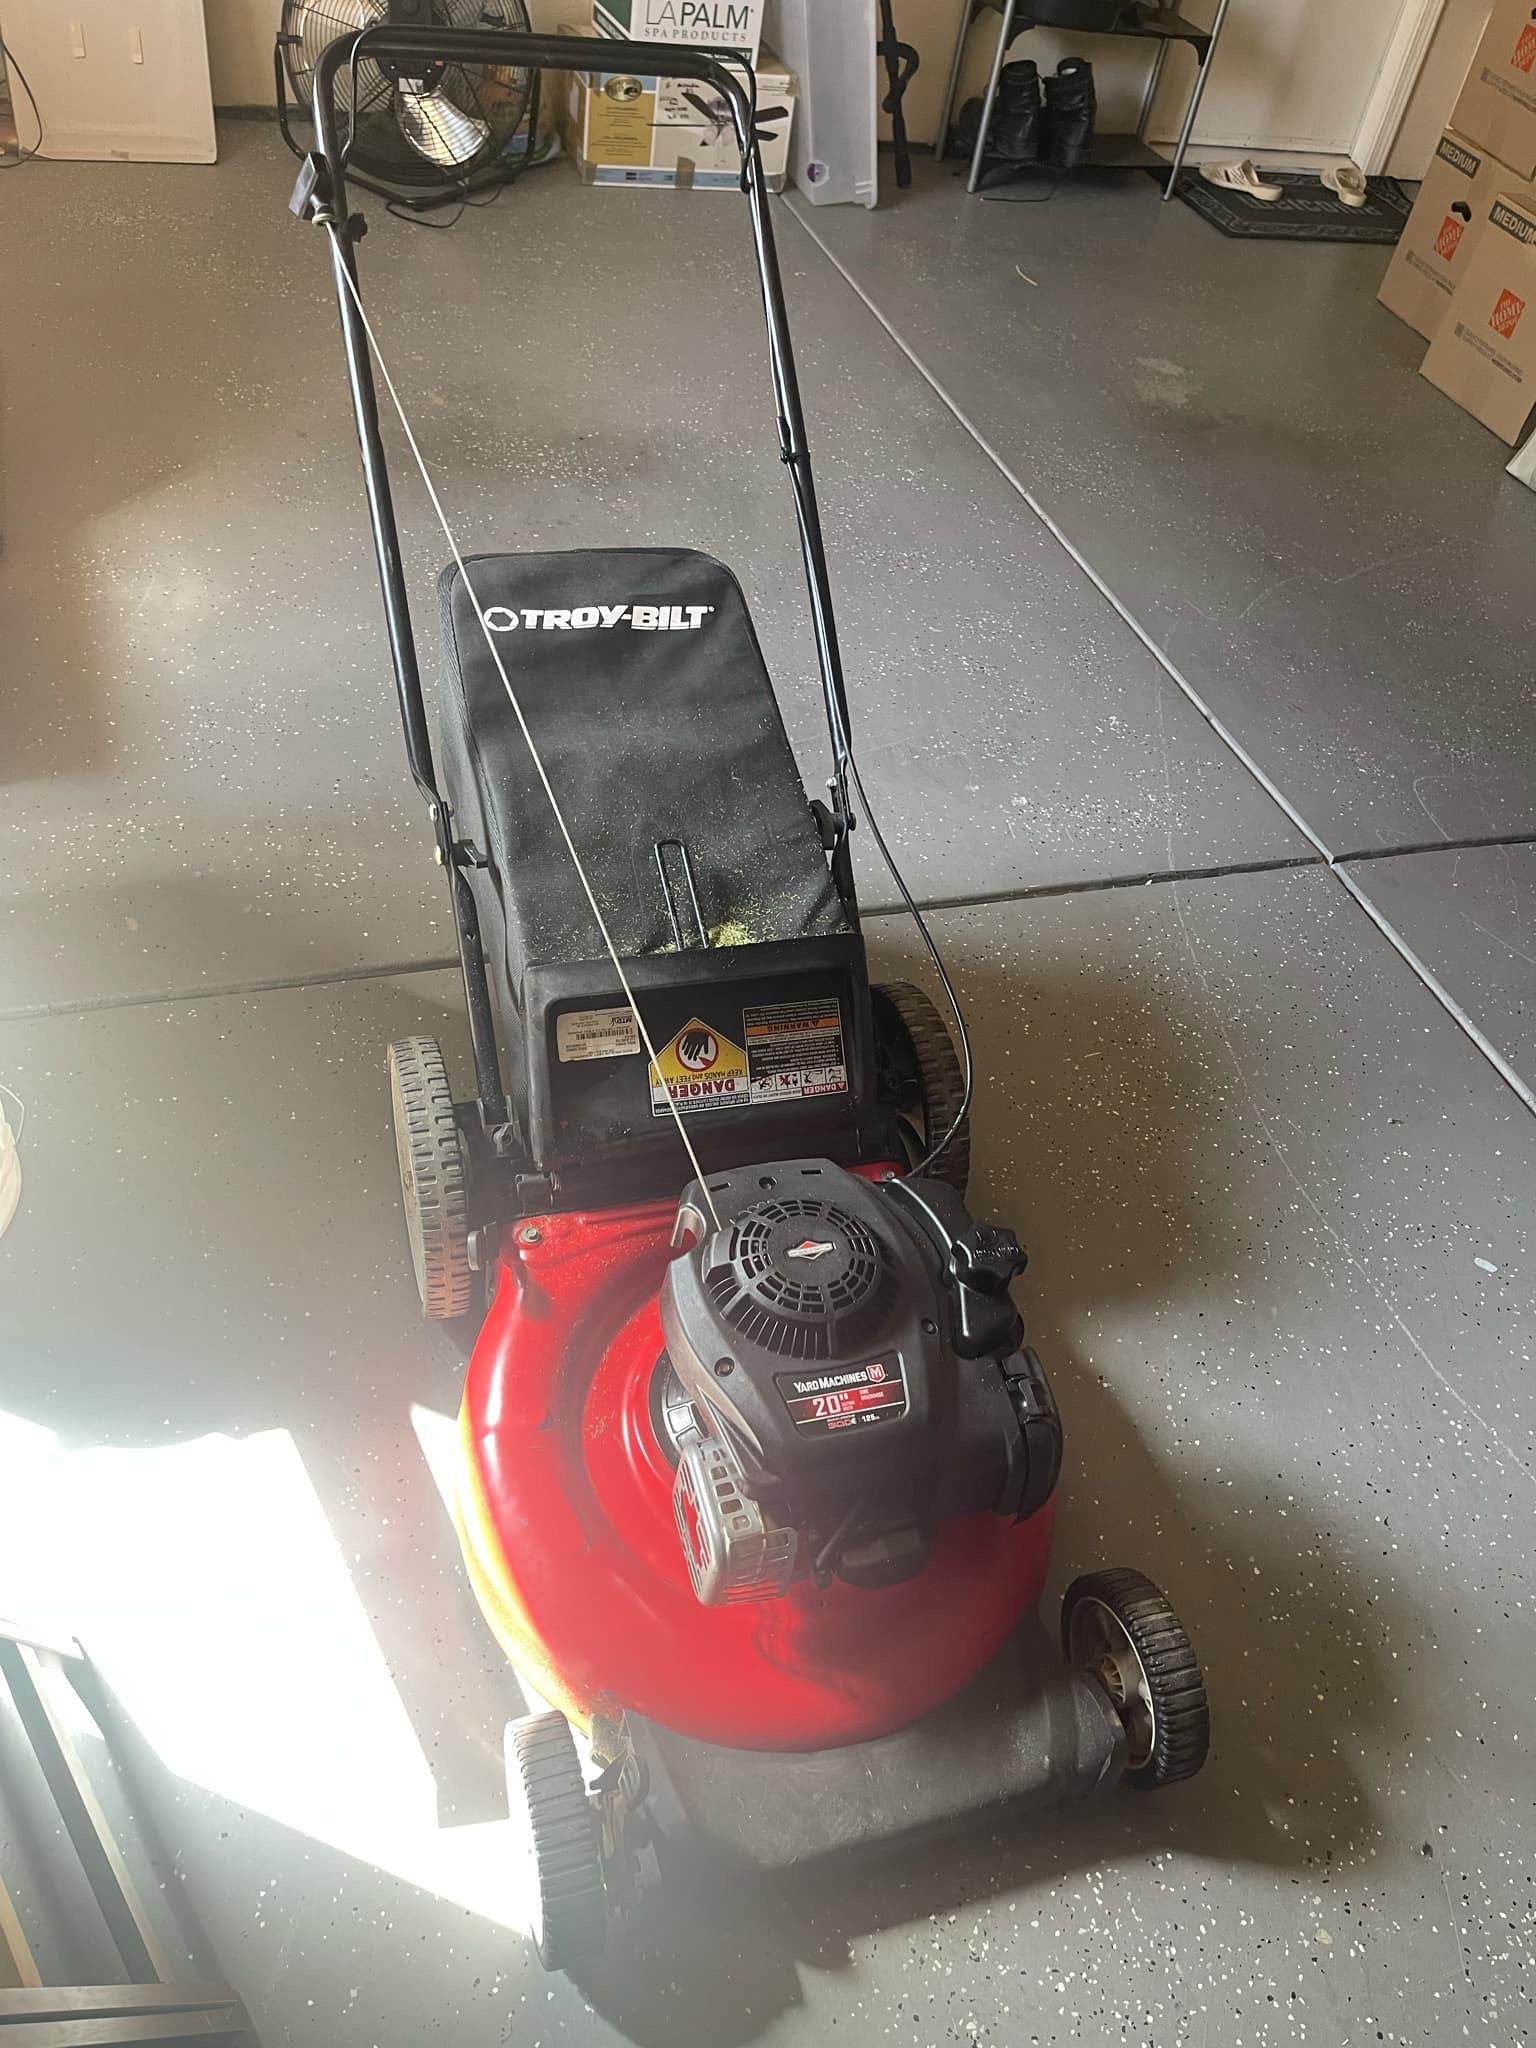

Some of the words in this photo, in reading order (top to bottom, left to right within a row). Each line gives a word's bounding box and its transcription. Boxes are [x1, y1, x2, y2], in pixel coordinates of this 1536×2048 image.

[644, 27, 668, 38] SPA
[672, 28, 748, 41] PRODUCTS
[1441, 141, 1478, 175] MEDIUM
[1494, 206, 1536, 245] MEDIUM
[520, 605, 708, 630] TROY-BILT
[768, 1021, 810, 1033] WARNING
[676, 1075, 691, 1083] FEET
[704, 1071, 726, 1080] HANDS
[726, 1069, 743, 1077] KEEP
[668, 1079, 735, 1099] DANGER
[803, 1083, 837, 1095] DANGER
[793, 1381, 820, 1394] YARD
[819, 1371, 868, 1390] MACHINES
[812, 1393, 849, 1418] 20"
